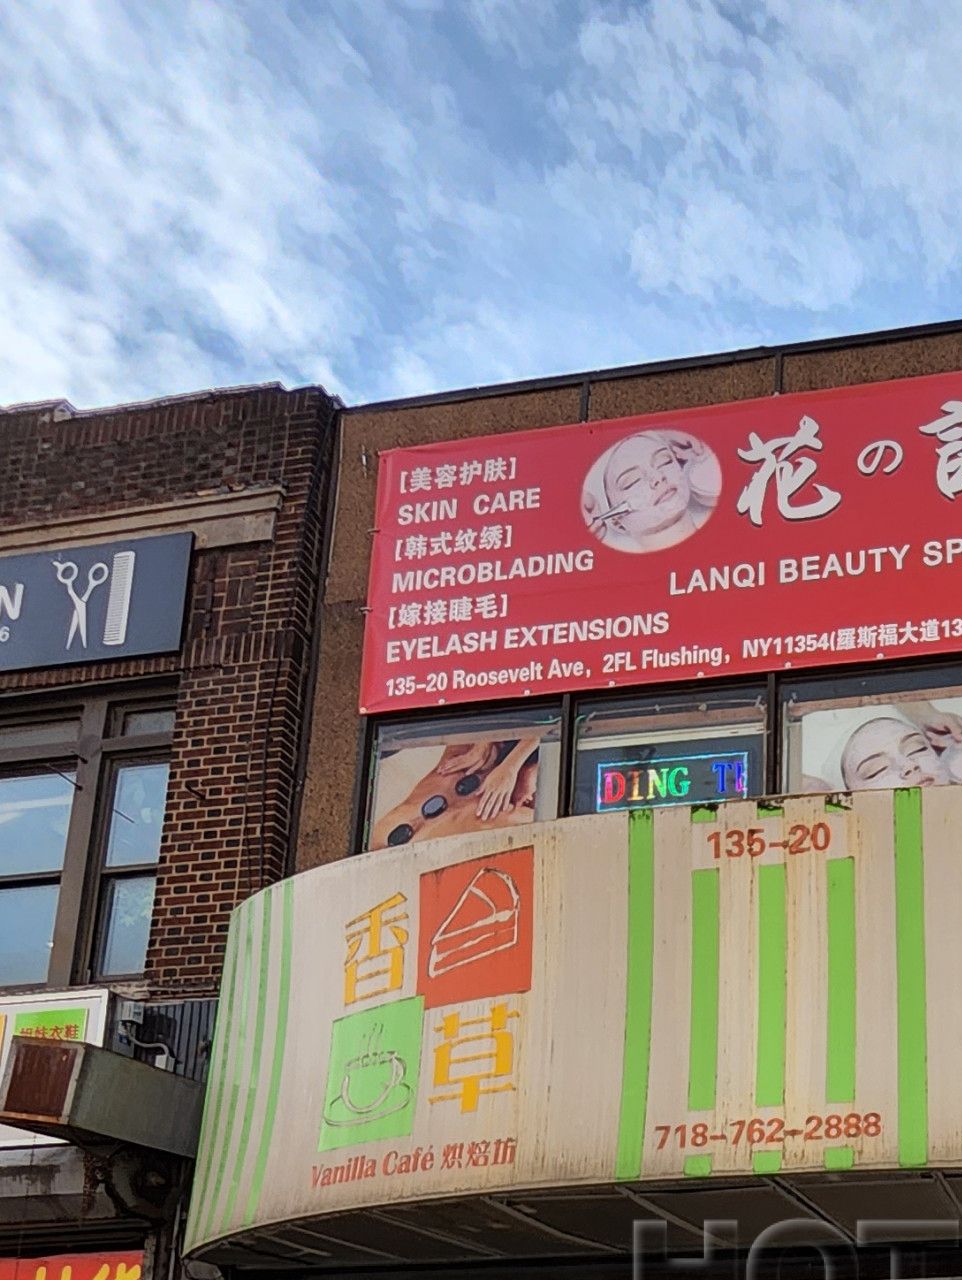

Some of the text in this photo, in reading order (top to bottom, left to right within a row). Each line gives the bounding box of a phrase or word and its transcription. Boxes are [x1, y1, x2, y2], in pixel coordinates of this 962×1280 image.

[400, 457, 517, 494] [美容护肤]
[397, 488, 541, 526] SKIN CARE
[395, 525, 513, 562] [韩式纹绣]
[392, 550, 594, 593] MICROBLADING
[669, 560, 766, 597] LANQI
[779, 544, 911, 585] BEAUTY
[386, 612, 670, 663] EYELASH EXTENSIONS
[385, 670, 449, 698] 135-20
[452, 660, 544, 690] Roosevelt
[547, 659, 592, 682] Ave,
[602, 652, 638, 675] 2FL
[642, 645, 731, 671] Flushing,
[600, 766, 691, 805] DING
[706, 821, 833, 860] 135-20
[342, 891, 409, 1006] 香
[426, 1003, 520, 1114] 草
[653, 1111, 884, 1151] 718-762-2888
[311, 1154, 376, 1189] Vanilla
[381, 1144, 435, 1177] Café
